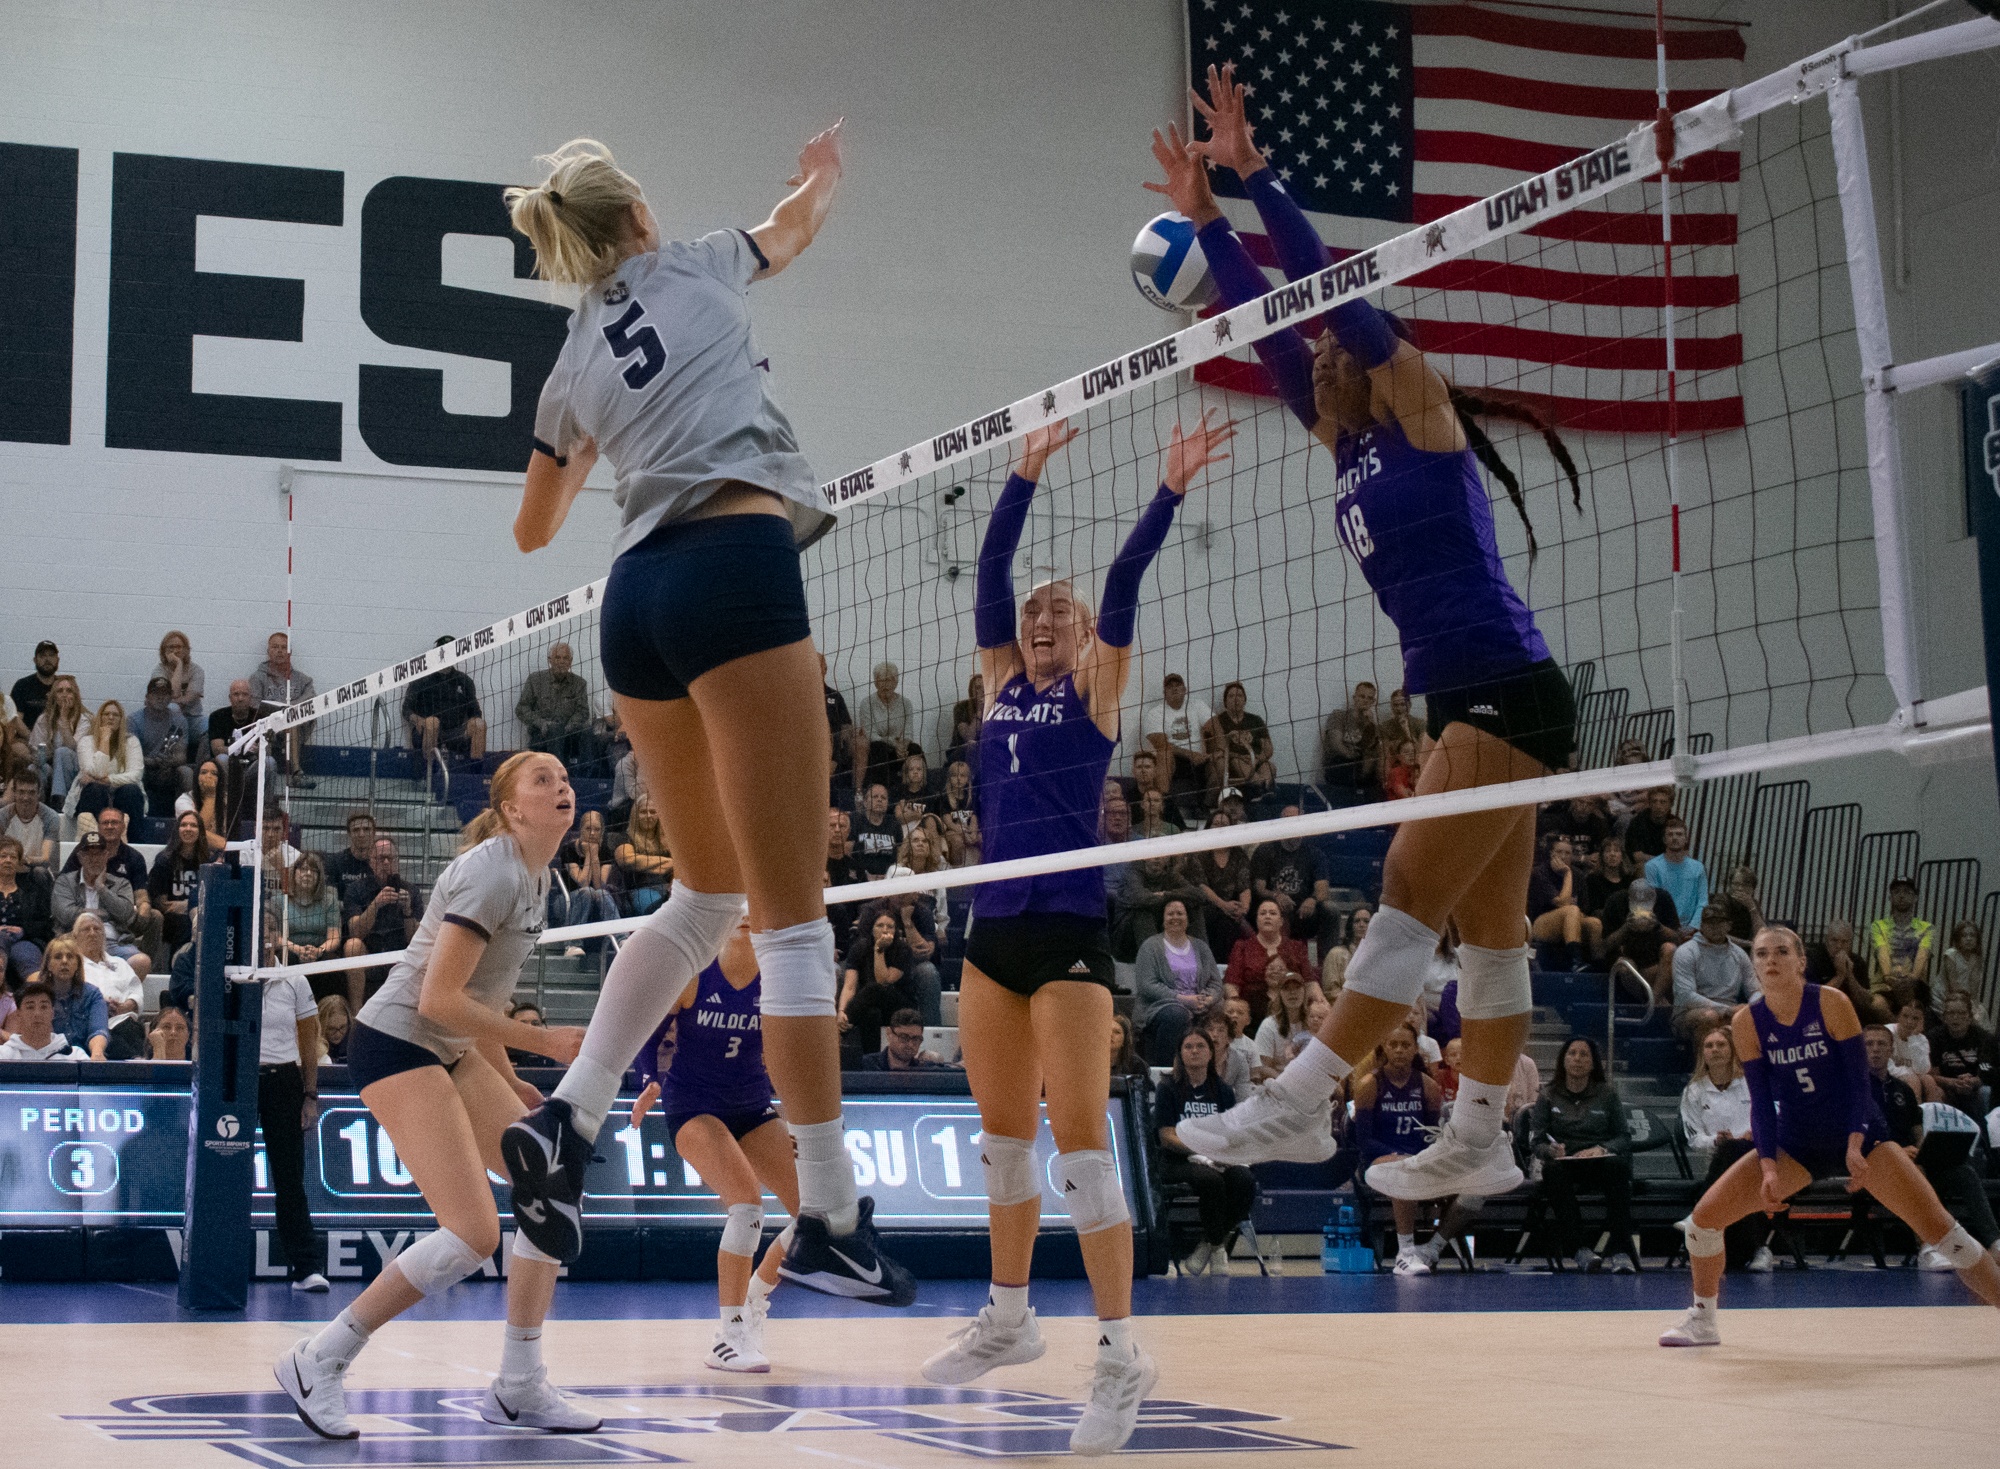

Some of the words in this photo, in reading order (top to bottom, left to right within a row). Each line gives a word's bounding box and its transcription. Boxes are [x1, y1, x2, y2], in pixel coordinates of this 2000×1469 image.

[1485, 174, 1548, 232] UTAH
[1554, 142, 1632, 201] STATE
[1262, 280, 1315, 326] UTAH
[1320, 250, 1381, 301] STATE
[601, 298, 667, 390] 5
[1081, 359, 1125, 400] UTAH
[1128, 337, 1178, 381] STATE
[932, 427, 968, 462] UTAH
[971, 407, 1013, 447] STATE
[840, 466, 875, 501] STATE
[1341, 503, 1375, 564] 18
[525, 609, 546, 629] UTAH
[547, 594, 570, 621] STATE
[455, 635, 473, 657] UTAH
[474, 626, 494, 650] STATE
[392, 664, 409, 683] UTAH
[410, 654, 427, 676] STATE
[336, 687, 351, 704] UTAH
[352, 678, 368, 698] STATE
[1007, 733, 1020, 774] 1
[724, 1036, 743, 1059] 3
[1795, 1067, 1816, 1093] 5
[20, 1108, 145, 1132] PERIOD
[1184, 1101, 1219, 1114] AGGIE
[1381, 1101, 1423, 1112] WILDCATS
[1396, 1116, 1413, 1135] 13
[71, 1148, 95, 1189] 3
[843, 1128, 908, 1187] SU
